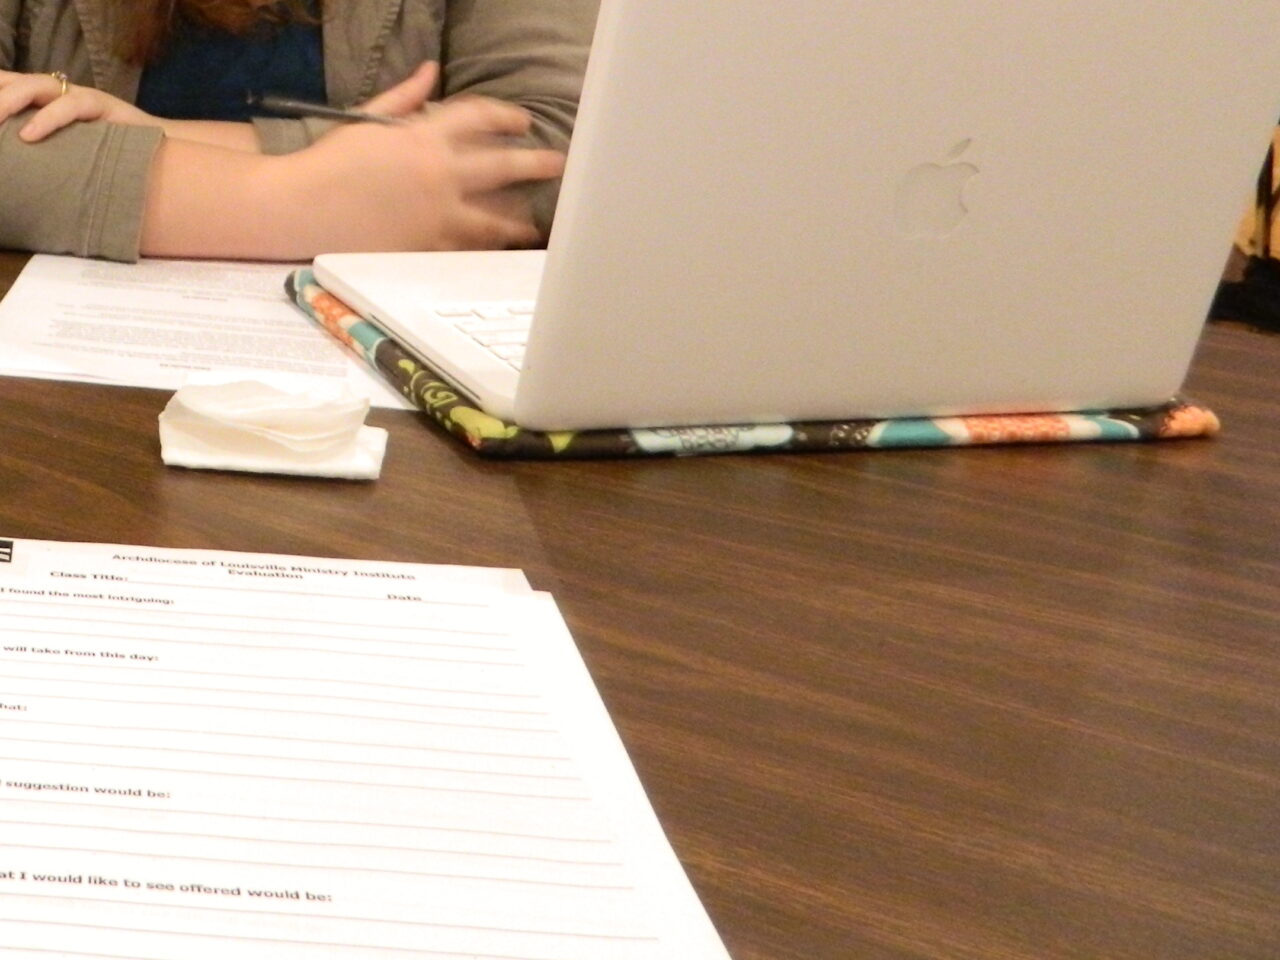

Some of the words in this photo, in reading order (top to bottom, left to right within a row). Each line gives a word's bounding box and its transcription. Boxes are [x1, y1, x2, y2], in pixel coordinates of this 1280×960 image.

[112, 553, 198, 566] Archdiocese
[220, 561, 287, 571] Louisville
[291, 566, 348, 577] Ministry
[352, 570, 416, 581] Institute
[228, 569, 303, 580] Evaluation
[50, 571, 87, 579] Class
[92, 573, 129, 582] Title:
[9, 587, 45, 596] found
[108, 594, 175, 605] intriguing:
[3, 645, 27, 653] will
[31, 647, 61, 655] take
[64, 649, 96, 658] from
[100, 651, 126, 660] this
[130, 653, 160, 662] day:
[5, 781, 90, 793] suggestion
[94, 788, 142, 798] would
[146, 790, 171, 799] be:
[19, 871, 27, 880] I
[32, 873, 83, 885] would
[87, 875, 119, 887] like
[123, 879, 141, 889] to
[145, 882, 175, 891] see
[179, 884, 241, 896] offered
[247, 888, 300, 900] would
[305, 892, 333, 902] be:
